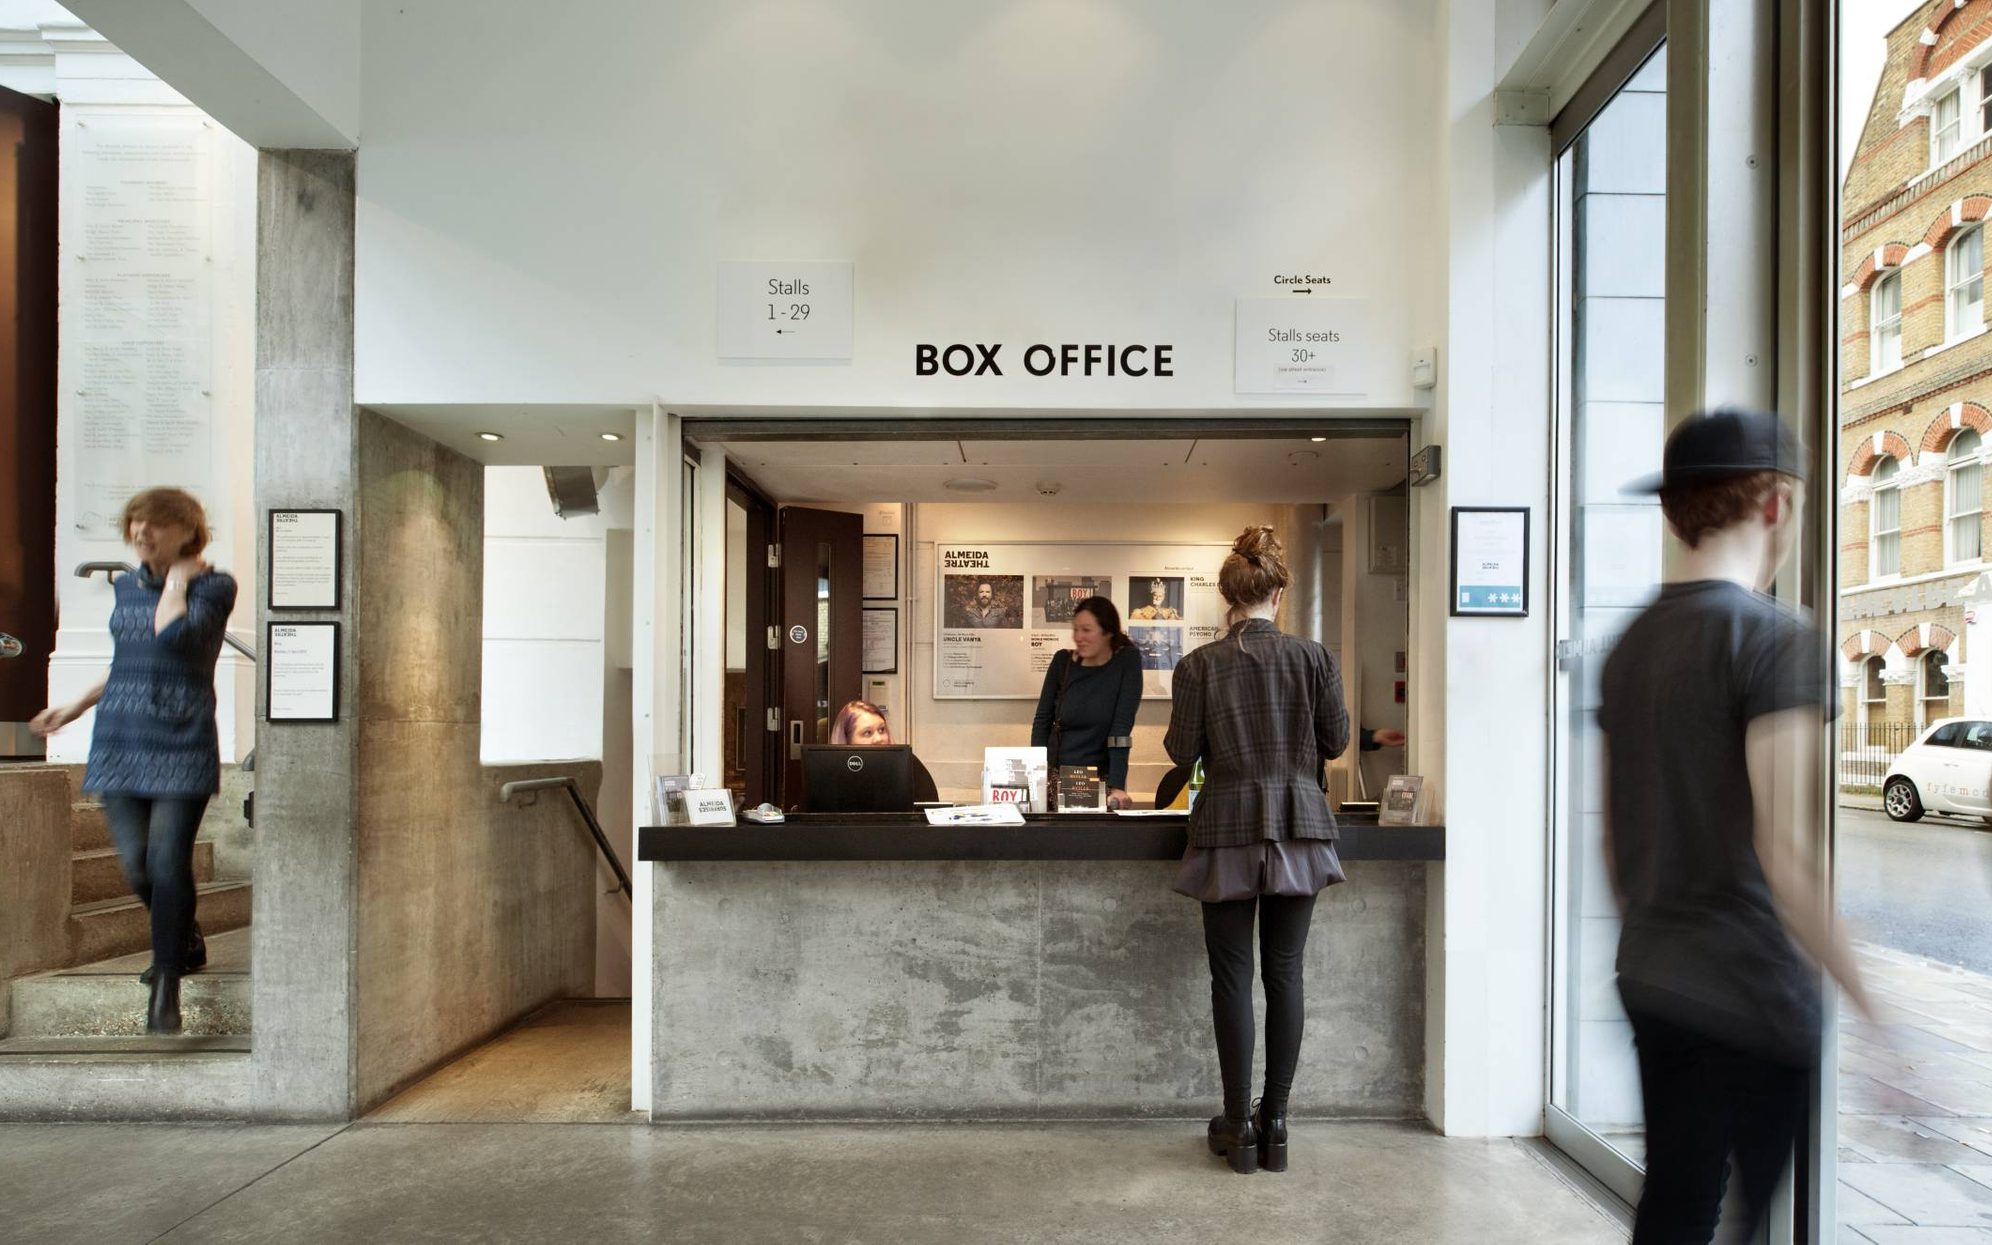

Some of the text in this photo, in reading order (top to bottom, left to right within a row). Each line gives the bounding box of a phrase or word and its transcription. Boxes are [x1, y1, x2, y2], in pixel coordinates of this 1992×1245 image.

[1273, 274, 1332, 285] Circle Seats
[768, 278, 810, 296] Stalls
[768, 303, 776, 320] 1
[790, 303, 811, 321] 29
[1268, 328, 1340, 342] Stalls seats
[915, 343, 1174, 377] BOX OFFICE
[1291, 348, 1316, 363] 30+
[944, 550, 989, 560] ALMEIDA
[944, 559, 990, 568] THEATRE
[1072, 588, 1088, 598] BOY
